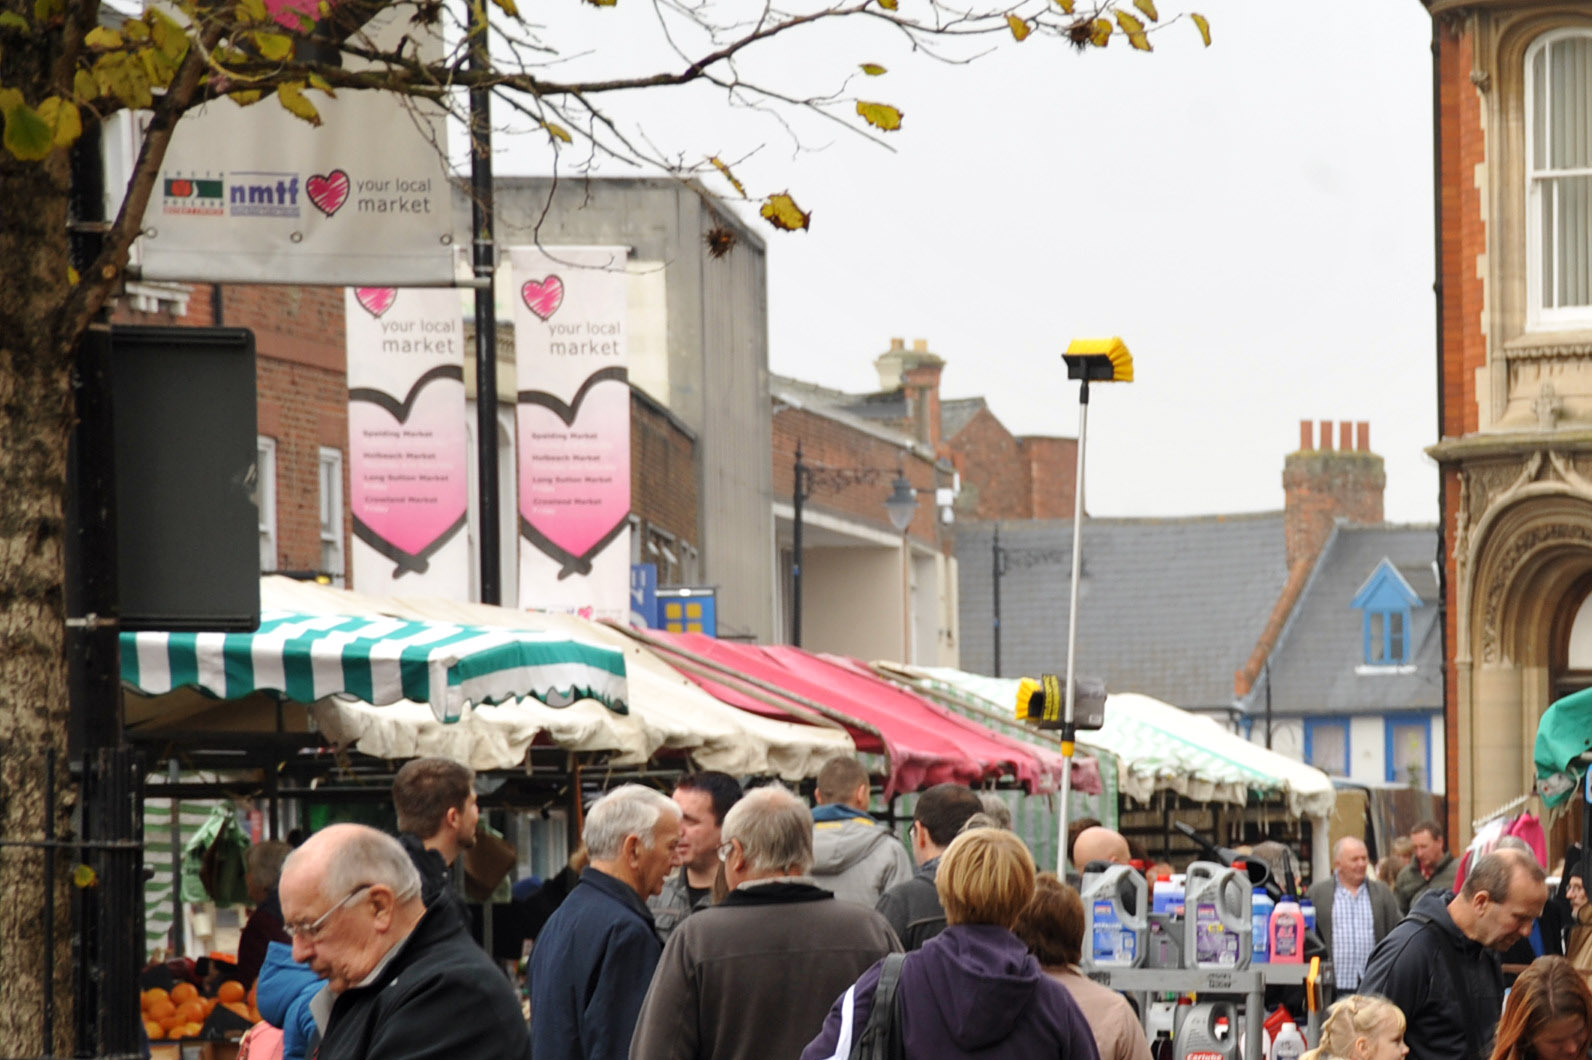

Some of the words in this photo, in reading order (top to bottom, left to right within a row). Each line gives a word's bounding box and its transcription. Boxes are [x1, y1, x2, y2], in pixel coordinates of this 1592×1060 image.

[230, 177, 299, 204] nmtf
[357, 179, 392, 195] your
[395, 178, 431, 193] local
[358, 196, 431, 214] market
[381, 321, 416, 334] your
[420, 319, 456, 333] local
[549, 323, 582, 337] your
[586, 321, 621, 335] local
[382, 337, 455, 354] market
[550, 339, 621, 356] market
